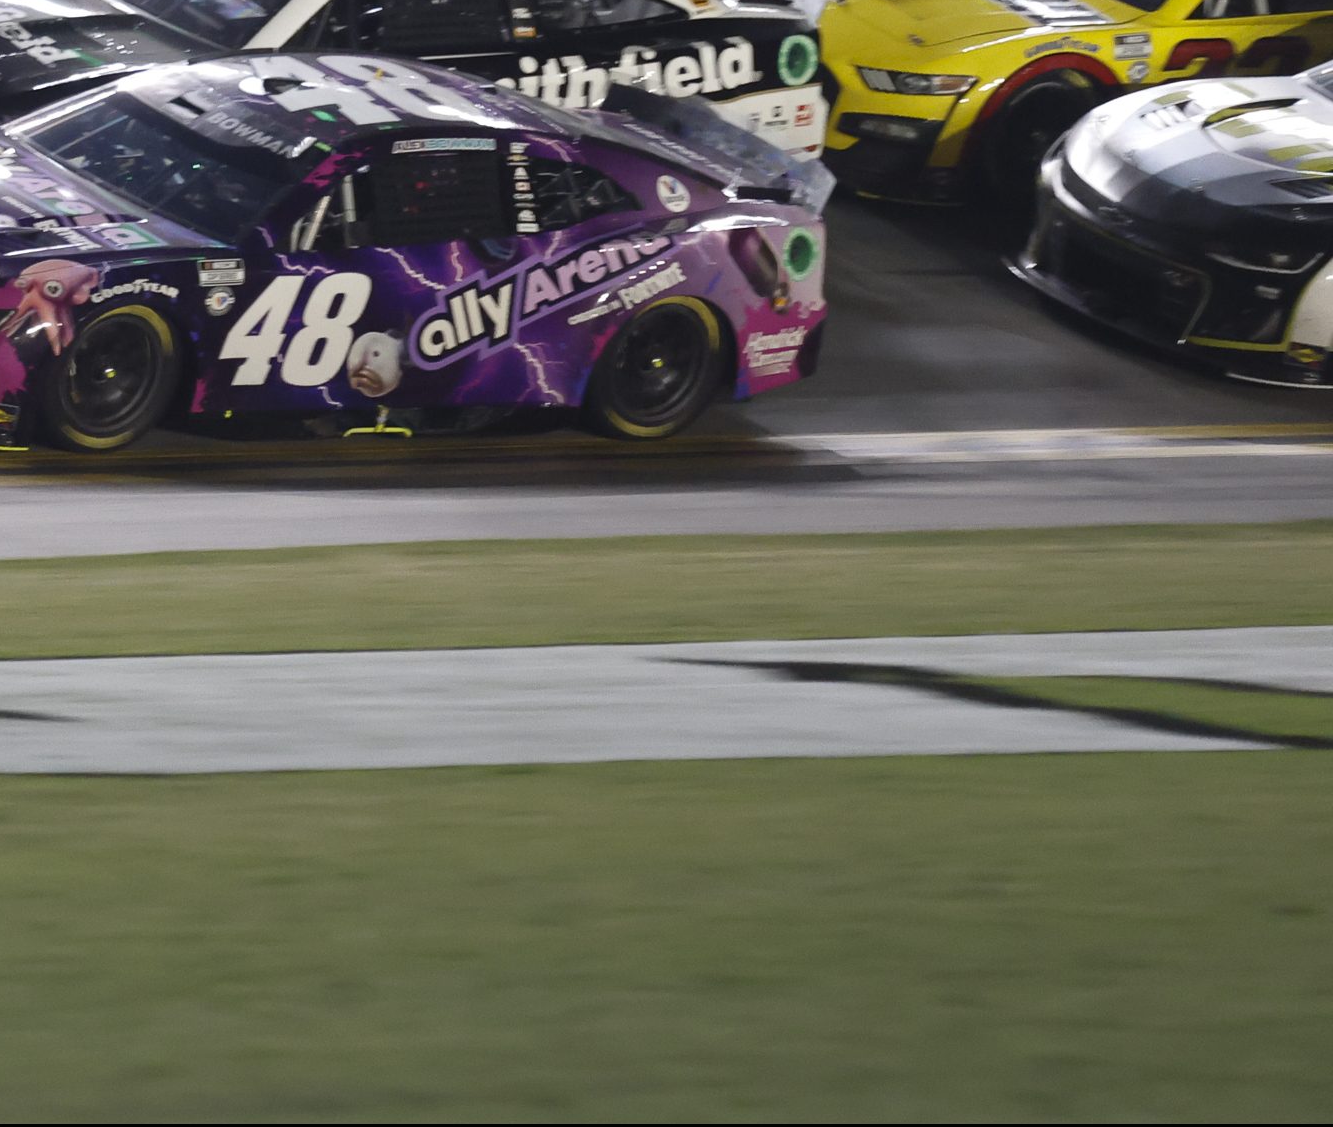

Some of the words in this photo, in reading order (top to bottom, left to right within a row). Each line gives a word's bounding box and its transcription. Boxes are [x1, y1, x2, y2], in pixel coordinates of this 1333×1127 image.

[495, 36, 763, 110] ithfield
[90, 278, 180, 304] GOODYEAR
[217, 272, 372, 387] 48
[419, 283, 514, 357] ally
[523, 234, 672, 315] Arena
